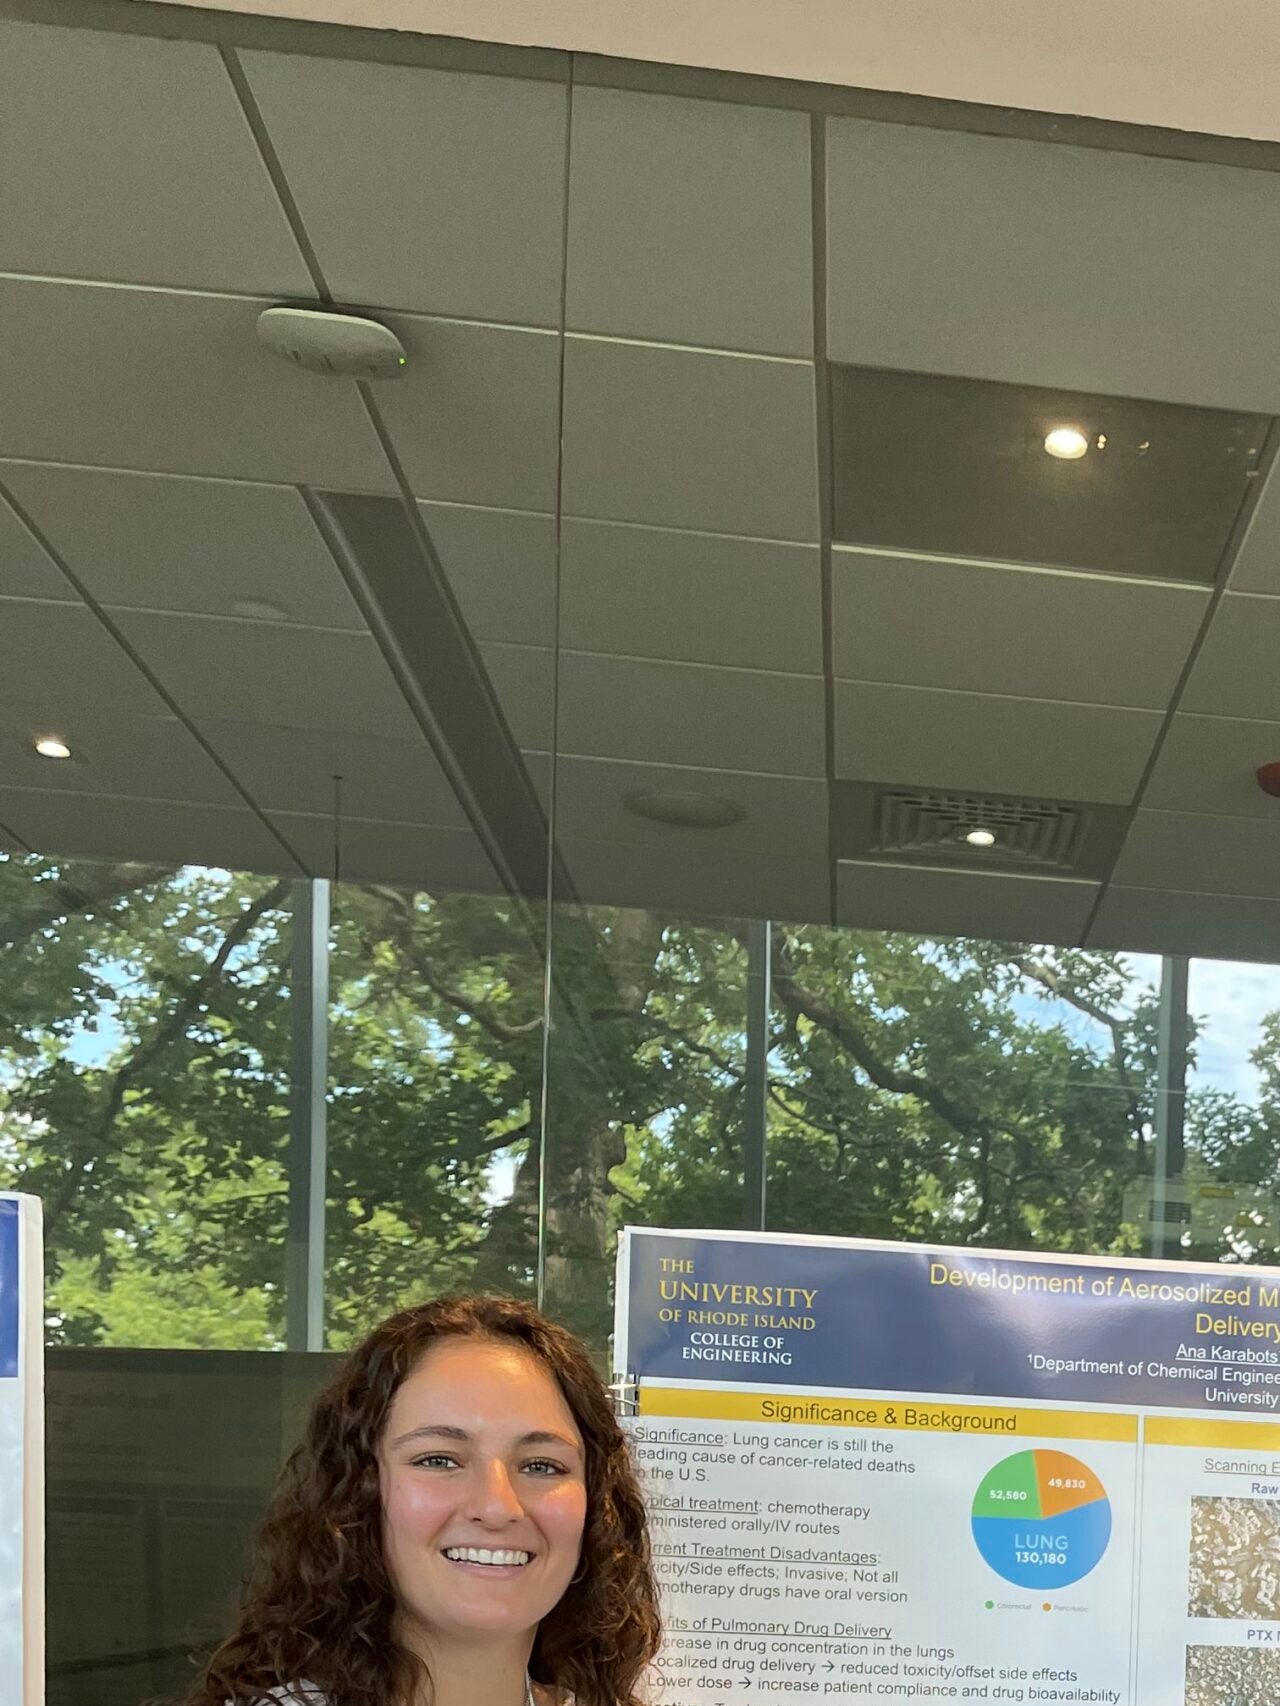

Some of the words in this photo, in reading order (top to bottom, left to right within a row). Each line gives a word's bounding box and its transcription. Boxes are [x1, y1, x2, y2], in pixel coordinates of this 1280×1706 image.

[659, 1258, 694, 1273] THE
[660, 1280, 818, 1308] UNIVERSITY
[930, 1263, 1085, 1296] Development
[1091, 1276, 1115, 1297] of
[1119, 1276, 1250, 1307] Aerosolized
[659, 1308, 682, 1322] OF
[688, 1311, 748, 1326] RHODE
[755, 1315, 815, 1330] ISLAND
[691, 1332, 758, 1347] COLLEGE
[764, 1337, 784, 1349] OF
[682, 1347, 792, 1365] ENGINEERING
[1175, 1343, 1207, 1361] Ana
[1127, 1360, 1144, 1376] of
[1146, 1362, 1218, 1380] Chemical
[1205, 1387, 1279, 1408] University
[760, 1400, 878, 1427] Significance
[883, 1407, 898, 1424] &
[904, 1408, 1017, 1435] Background
[633, 1427, 727, 1446] Significance:
[732, 1431, 770, 1450] Lung
[773, 1436, 824, 1450] cancer
[826, 1436, 840, 1450] is
[842, 1438, 867, 1452] still
[870, 1439, 894, 1453] the
[691, 1451, 736, 1464] cause
[740, 1451, 756, 1465] of
[758, 1453, 863, 1471] cancer-related
[866, 1458, 916, 1473] deaths
[1203, 1458, 1267, 1478] Scanning
[1250, 1482, 1279, 1494] Raw
[1014, 1533, 1068, 1551] LUNG
[1016, 1552, 1066, 1565] 130,180
[1246, 1629, 1273, 1641] PTX
